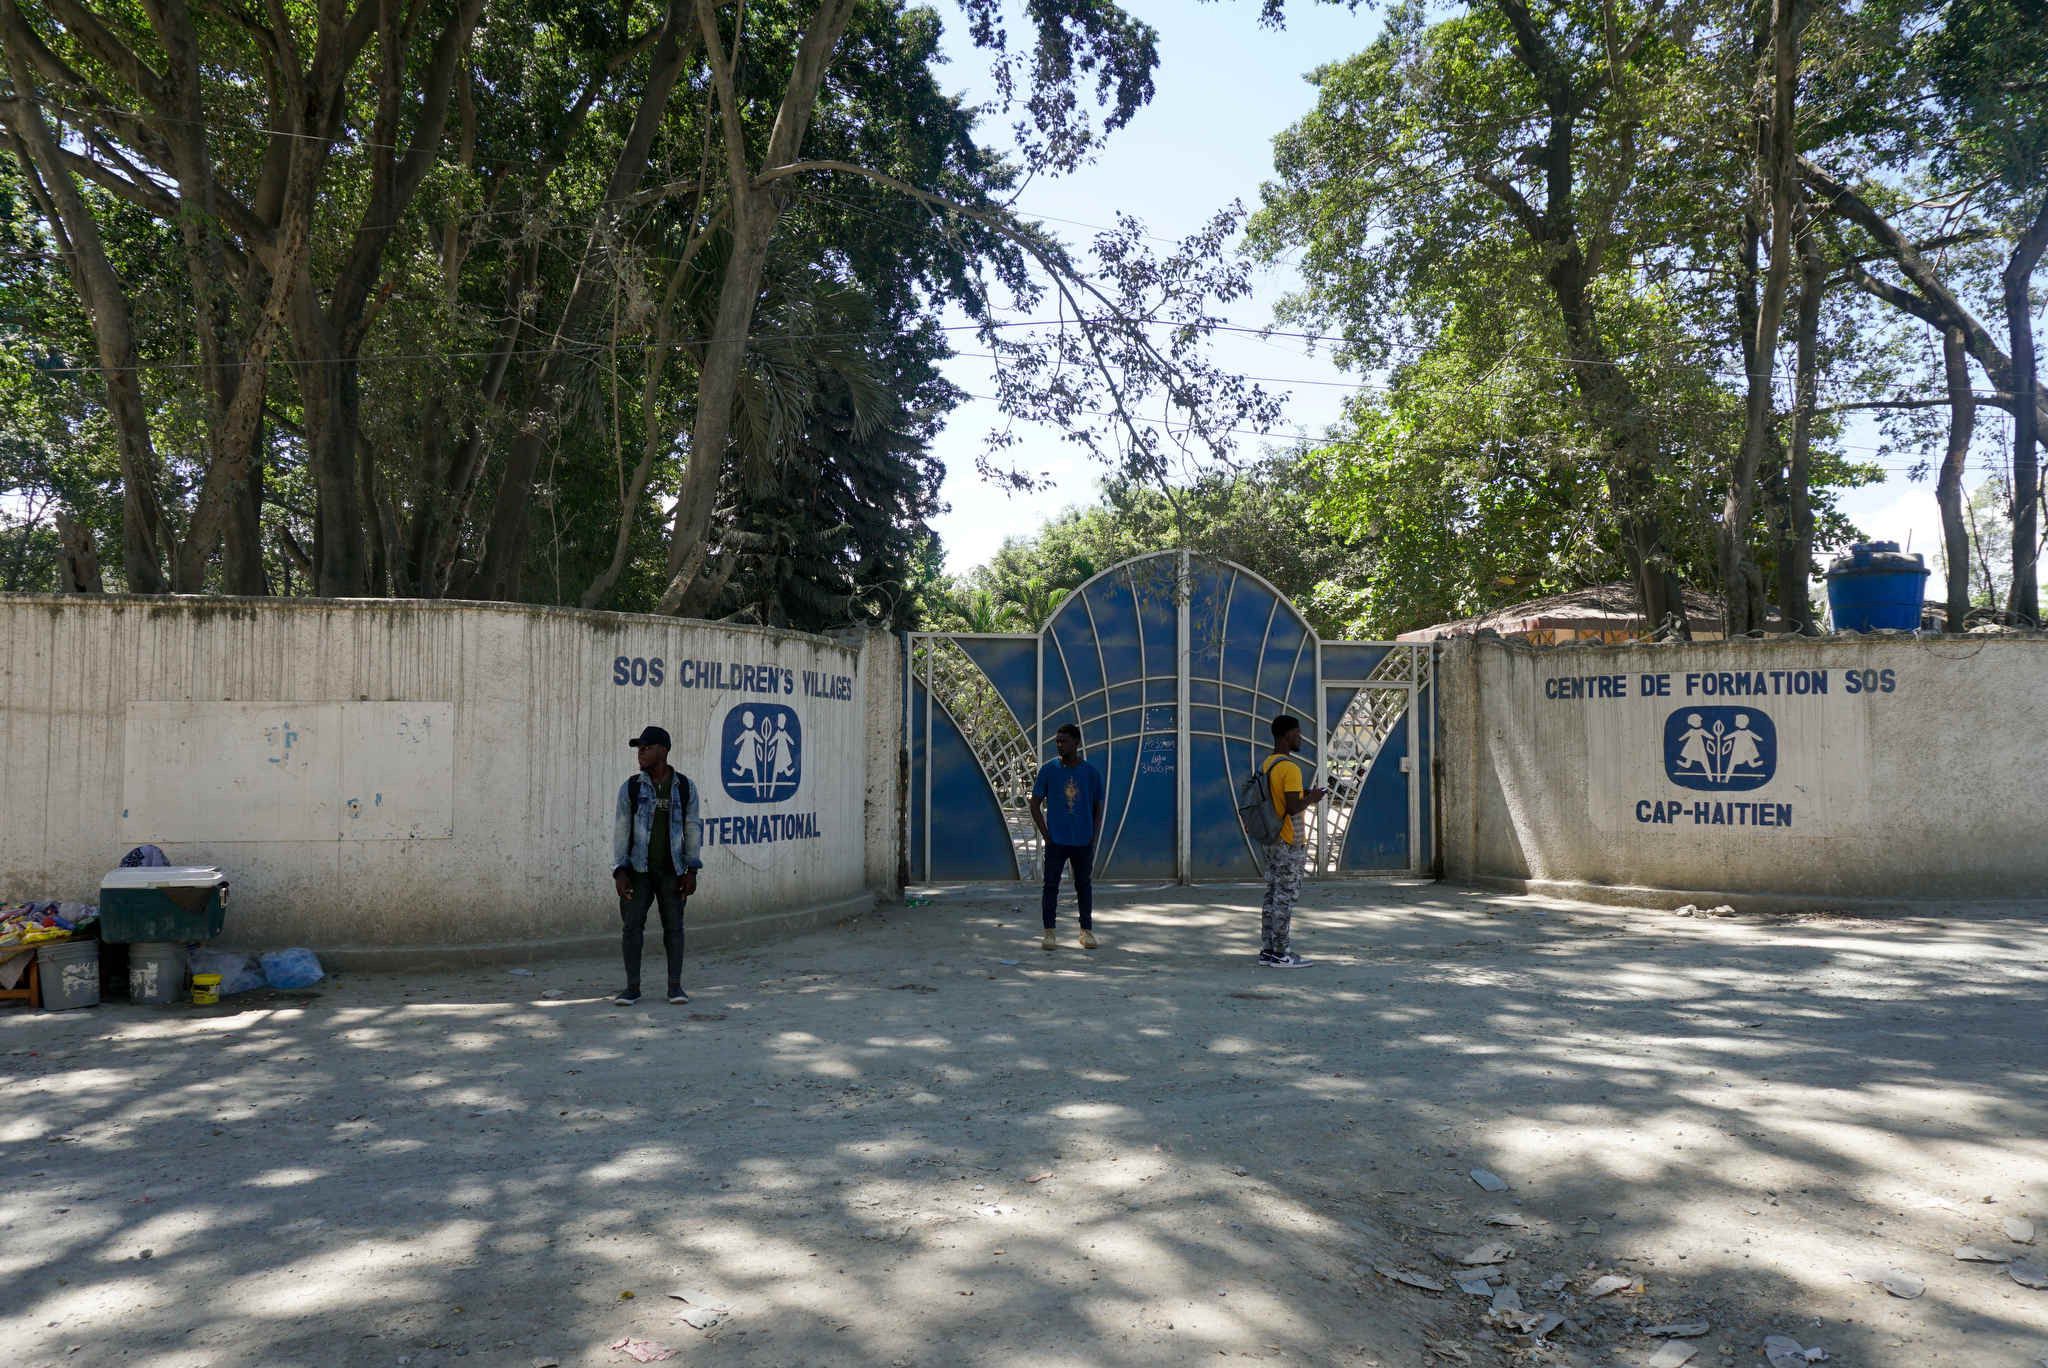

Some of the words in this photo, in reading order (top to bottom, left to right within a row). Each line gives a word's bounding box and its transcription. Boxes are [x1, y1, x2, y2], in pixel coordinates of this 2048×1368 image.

[613, 655, 665, 688] SOS
[680, 659, 794, 695] CHILDREN'S
[802, 670, 852, 701] VILLAGES
[1545, 674, 1627, 699] CENTRE
[1640, 673, 1672, 697] DE
[1686, 670, 1829, 697] FORMATION
[1845, 668, 1896, 694] SOS
[699, 811, 821, 847] TERNATIONAL
[1635, 799, 1793, 827] CAP-HAITIEN
